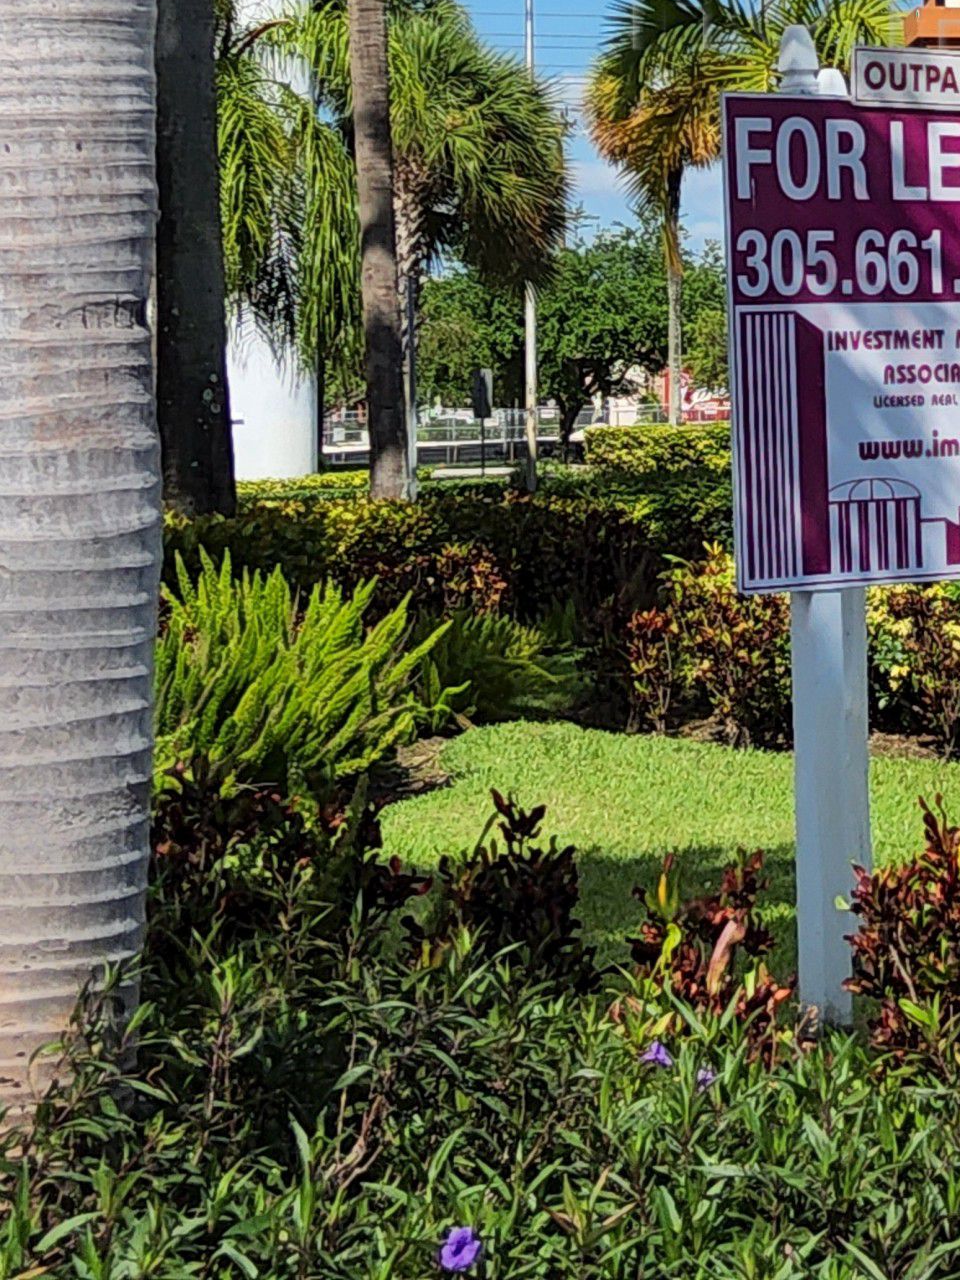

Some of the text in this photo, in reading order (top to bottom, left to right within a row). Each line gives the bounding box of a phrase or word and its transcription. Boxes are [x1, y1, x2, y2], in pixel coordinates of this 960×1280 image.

[734, 117, 870, 201] FOR
[828, 329, 945, 352] INVESTMENT
[873, 394, 925, 409] LICENSED
[931, 393, 958, 406] REAL
